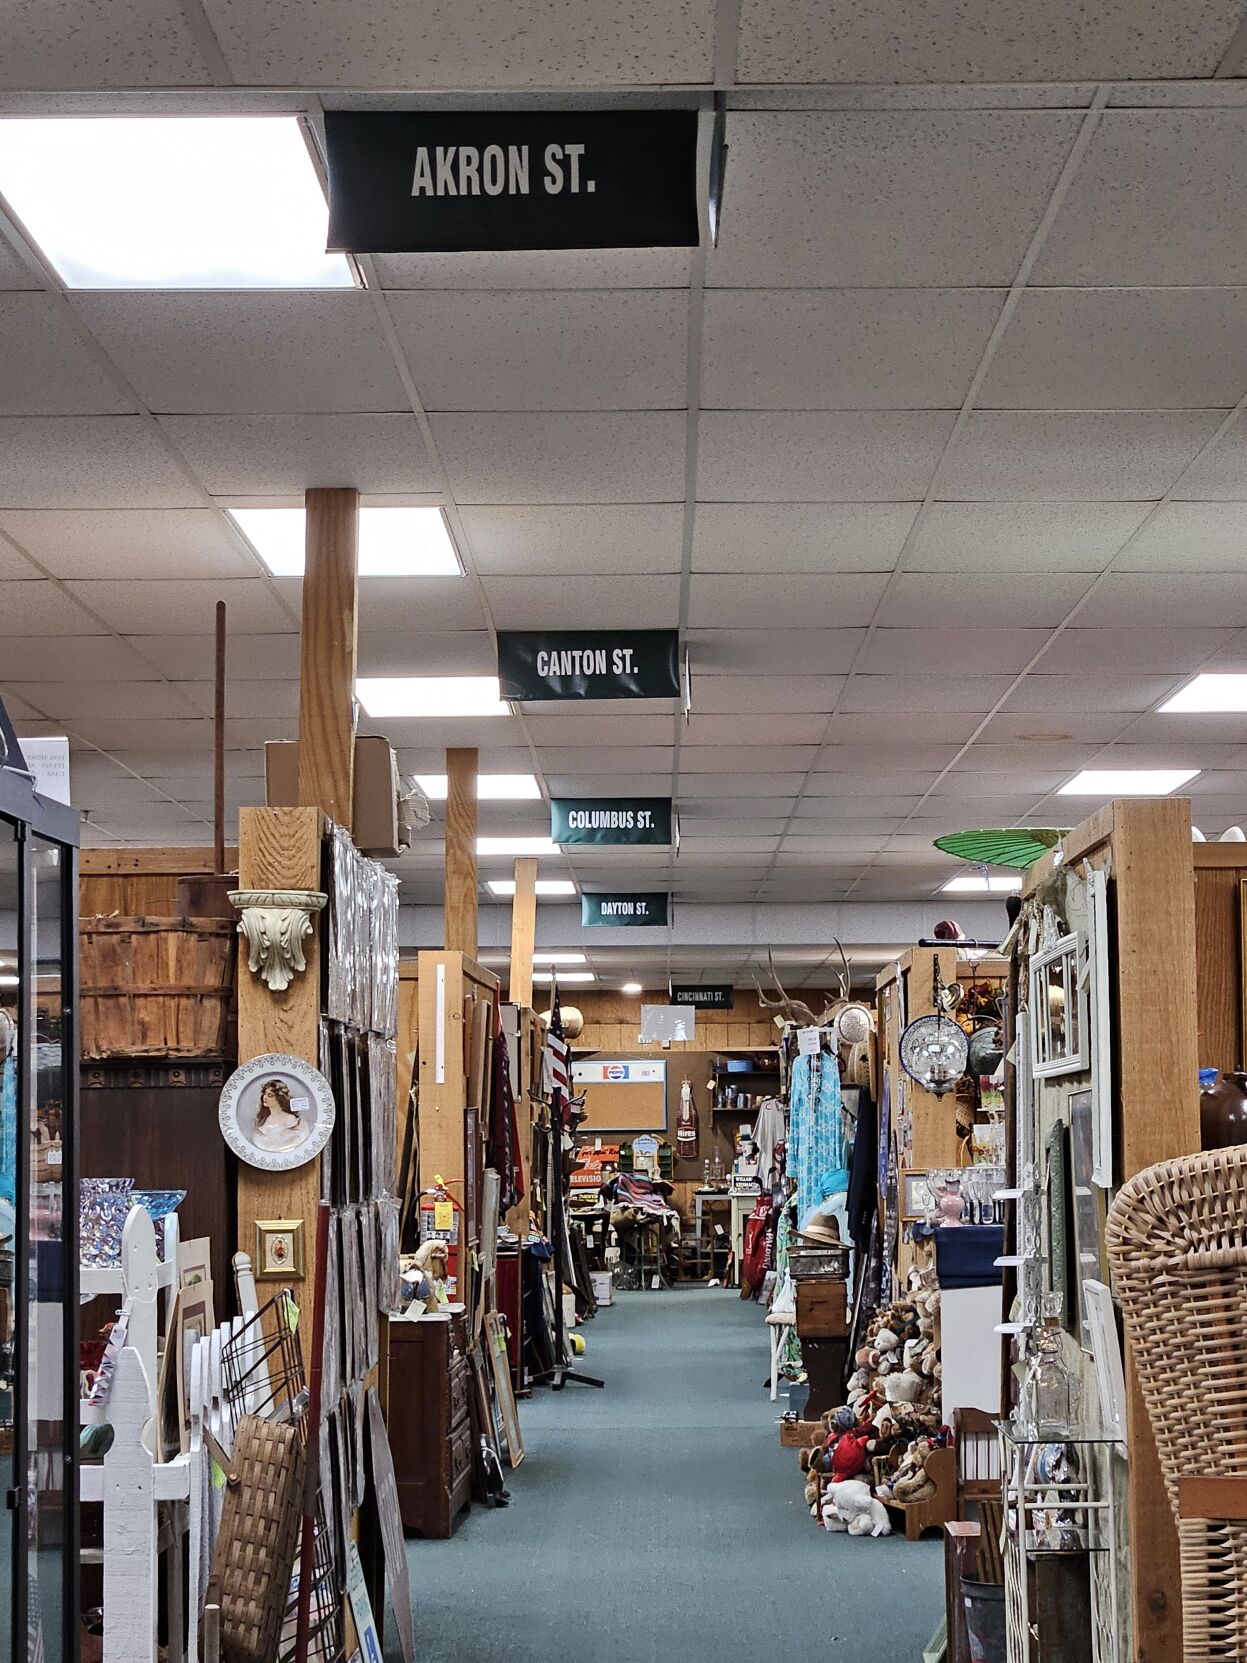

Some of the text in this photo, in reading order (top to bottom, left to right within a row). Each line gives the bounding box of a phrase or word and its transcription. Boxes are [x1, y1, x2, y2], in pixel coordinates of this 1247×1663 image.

[410, 142, 597, 198] AKRON ST.
[536, 648, 639, 677] CANTON ST.
[568, 810, 655, 830] COLUMBUS ST.
[600, 901, 649, 915] DAYTON ST.
[677, 991, 725, 1002] CINCINNATI ST.
[763, 1226, 774, 1269] SPALDING
